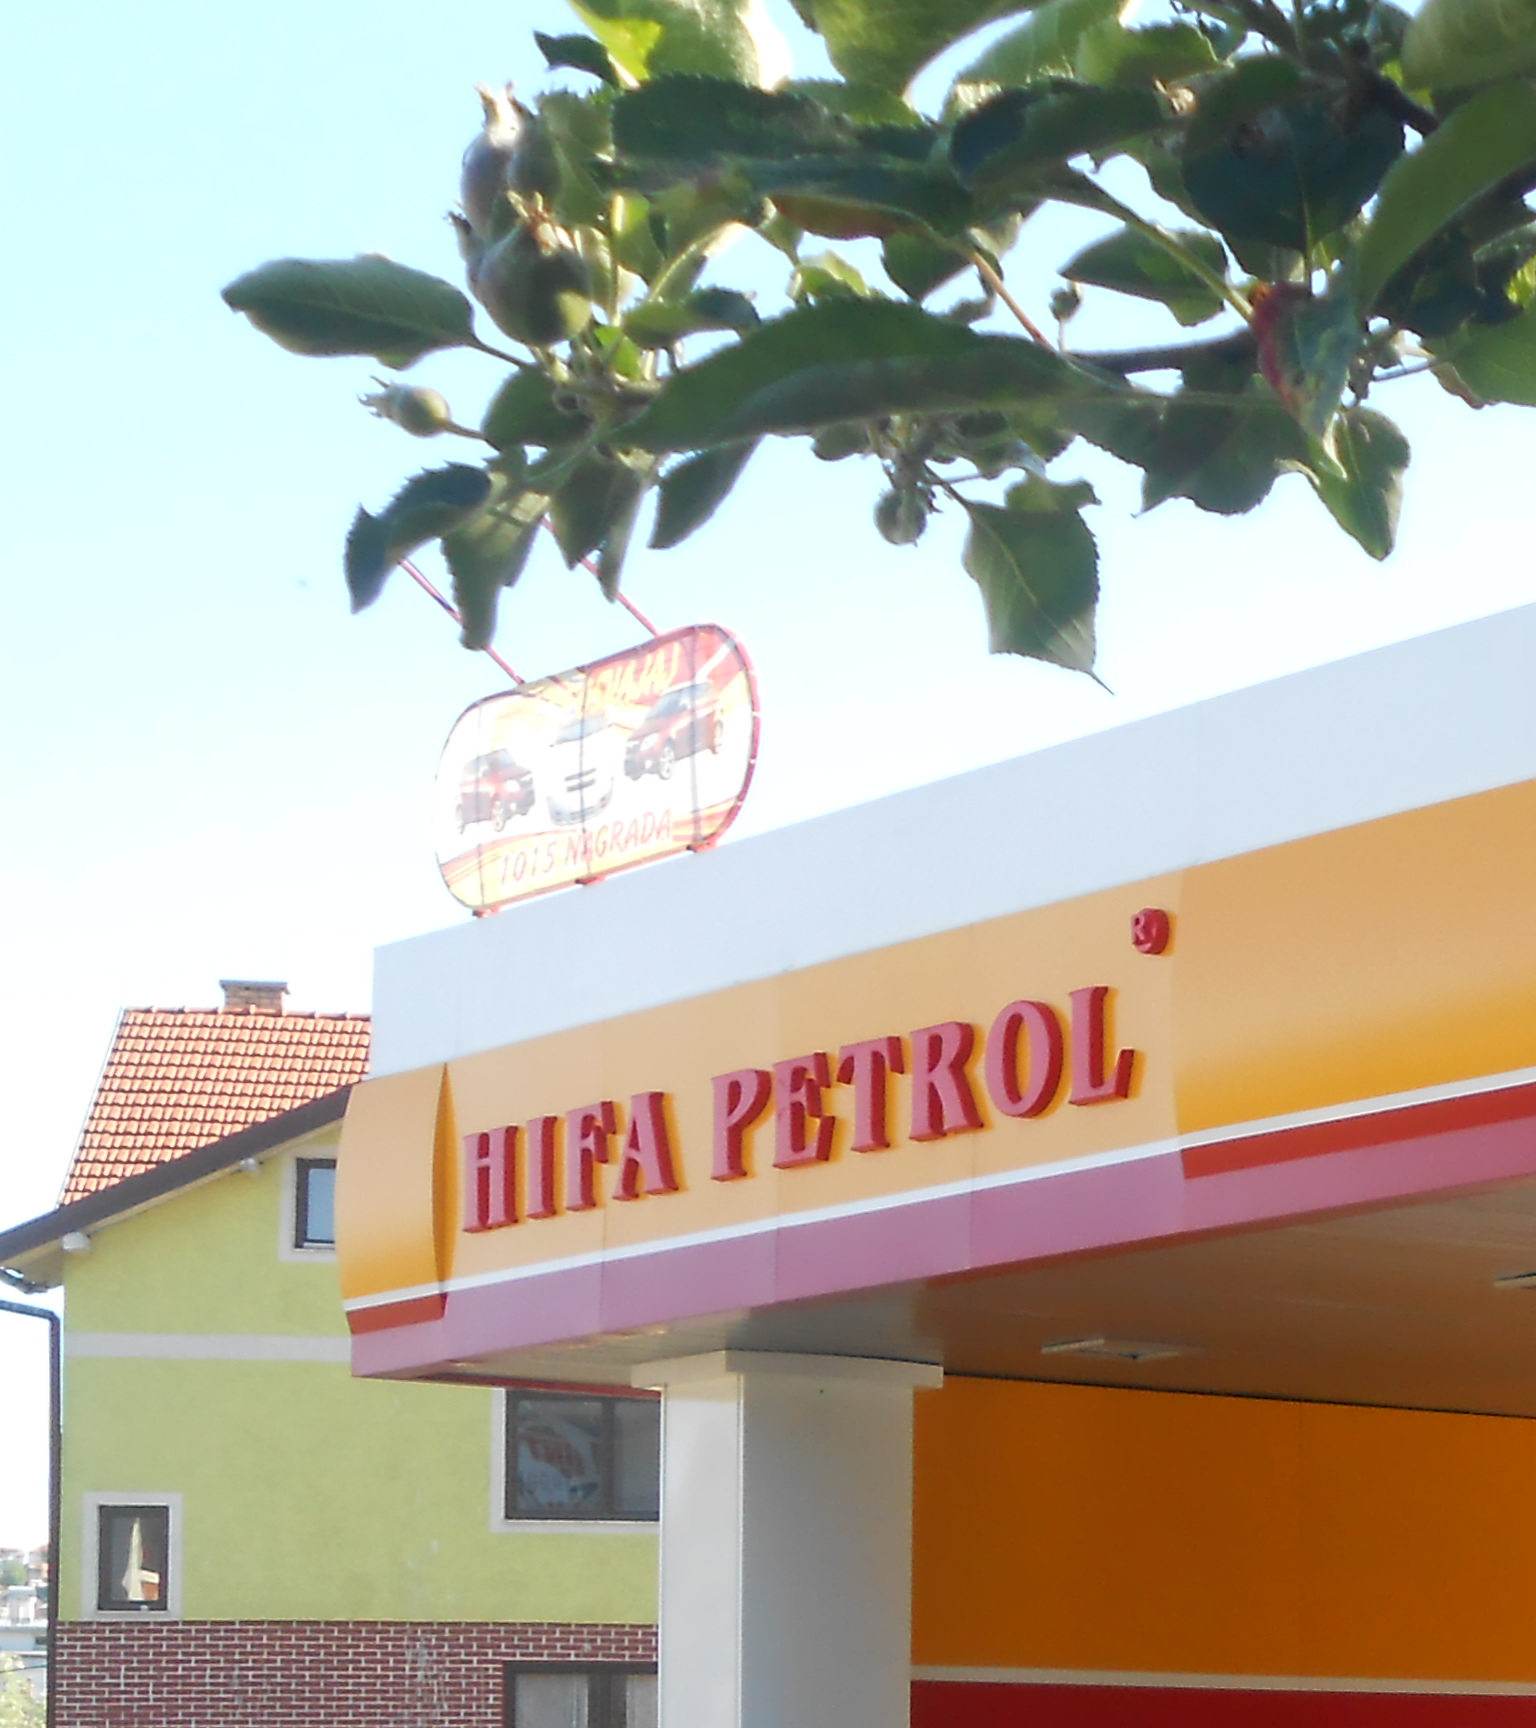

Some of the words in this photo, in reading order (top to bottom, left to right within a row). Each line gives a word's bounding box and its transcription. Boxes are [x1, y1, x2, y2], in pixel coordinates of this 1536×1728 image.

[501, 846, 556, 884] 1015
[565, 809, 672, 866] NAGRADA
[463, 1091, 678, 1233] HIFA
[712, 986, 1135, 1182] PETROL
